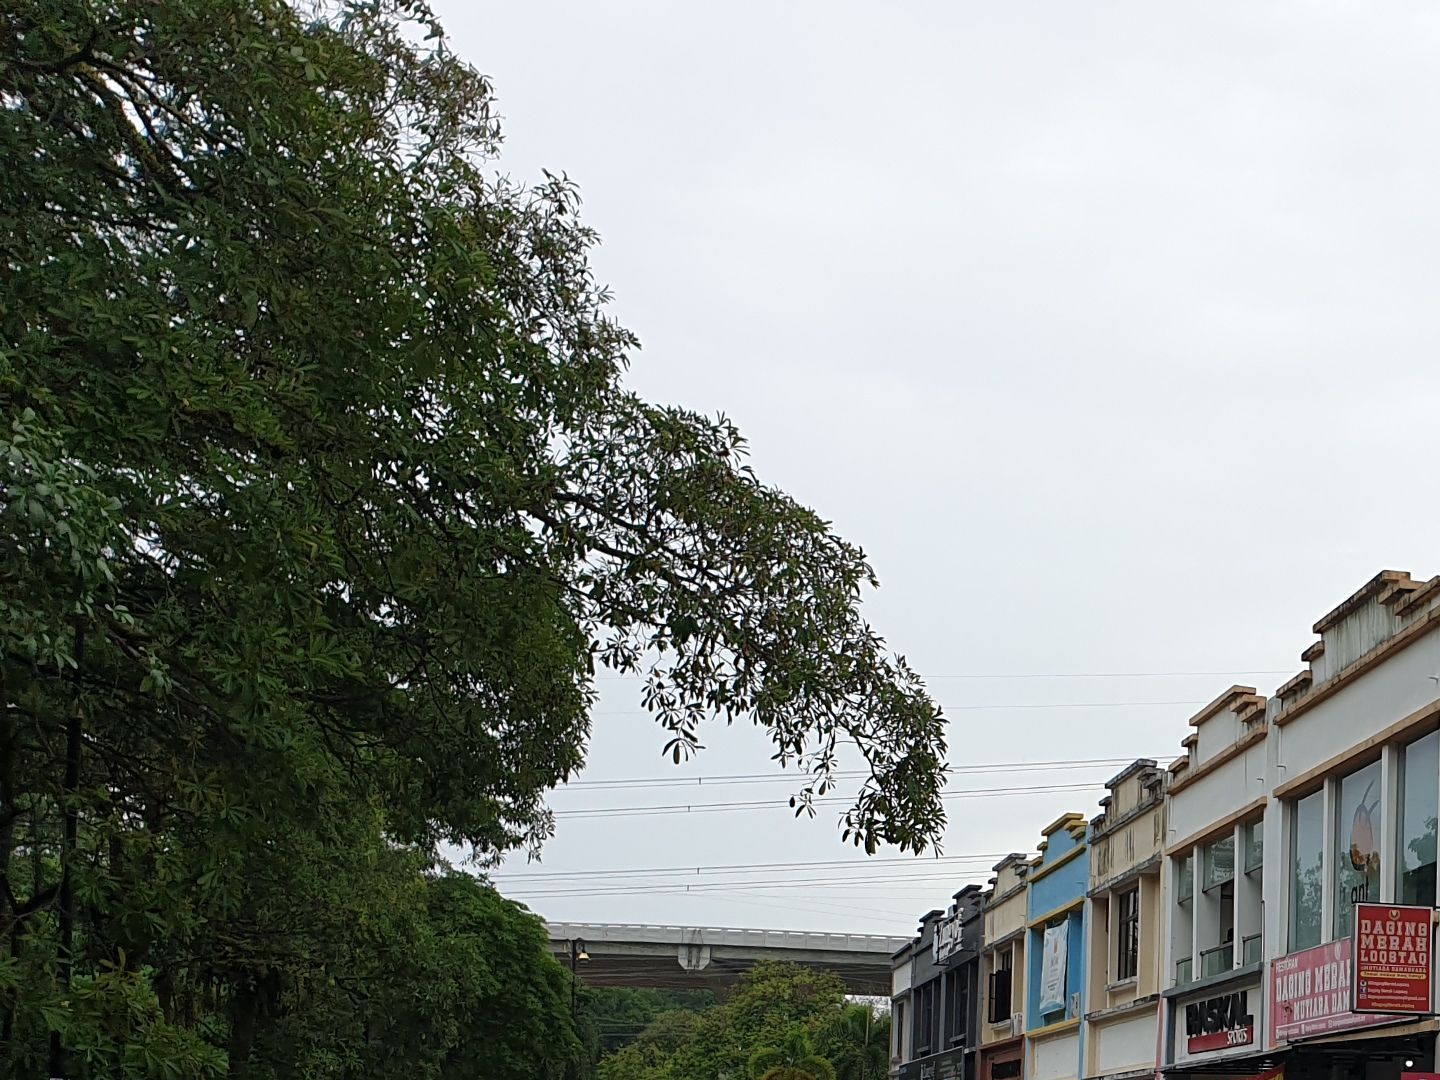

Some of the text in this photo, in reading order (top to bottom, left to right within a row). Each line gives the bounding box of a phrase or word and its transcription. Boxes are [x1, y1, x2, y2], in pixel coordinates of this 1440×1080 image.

[1361, 920, 1428, 936] DAGING
[1361, 934, 1427, 951] MERAH
[1276, 969, 1311, 1002] DAGING
[1293, 989, 1351, 1021] MUTIARA DAM
